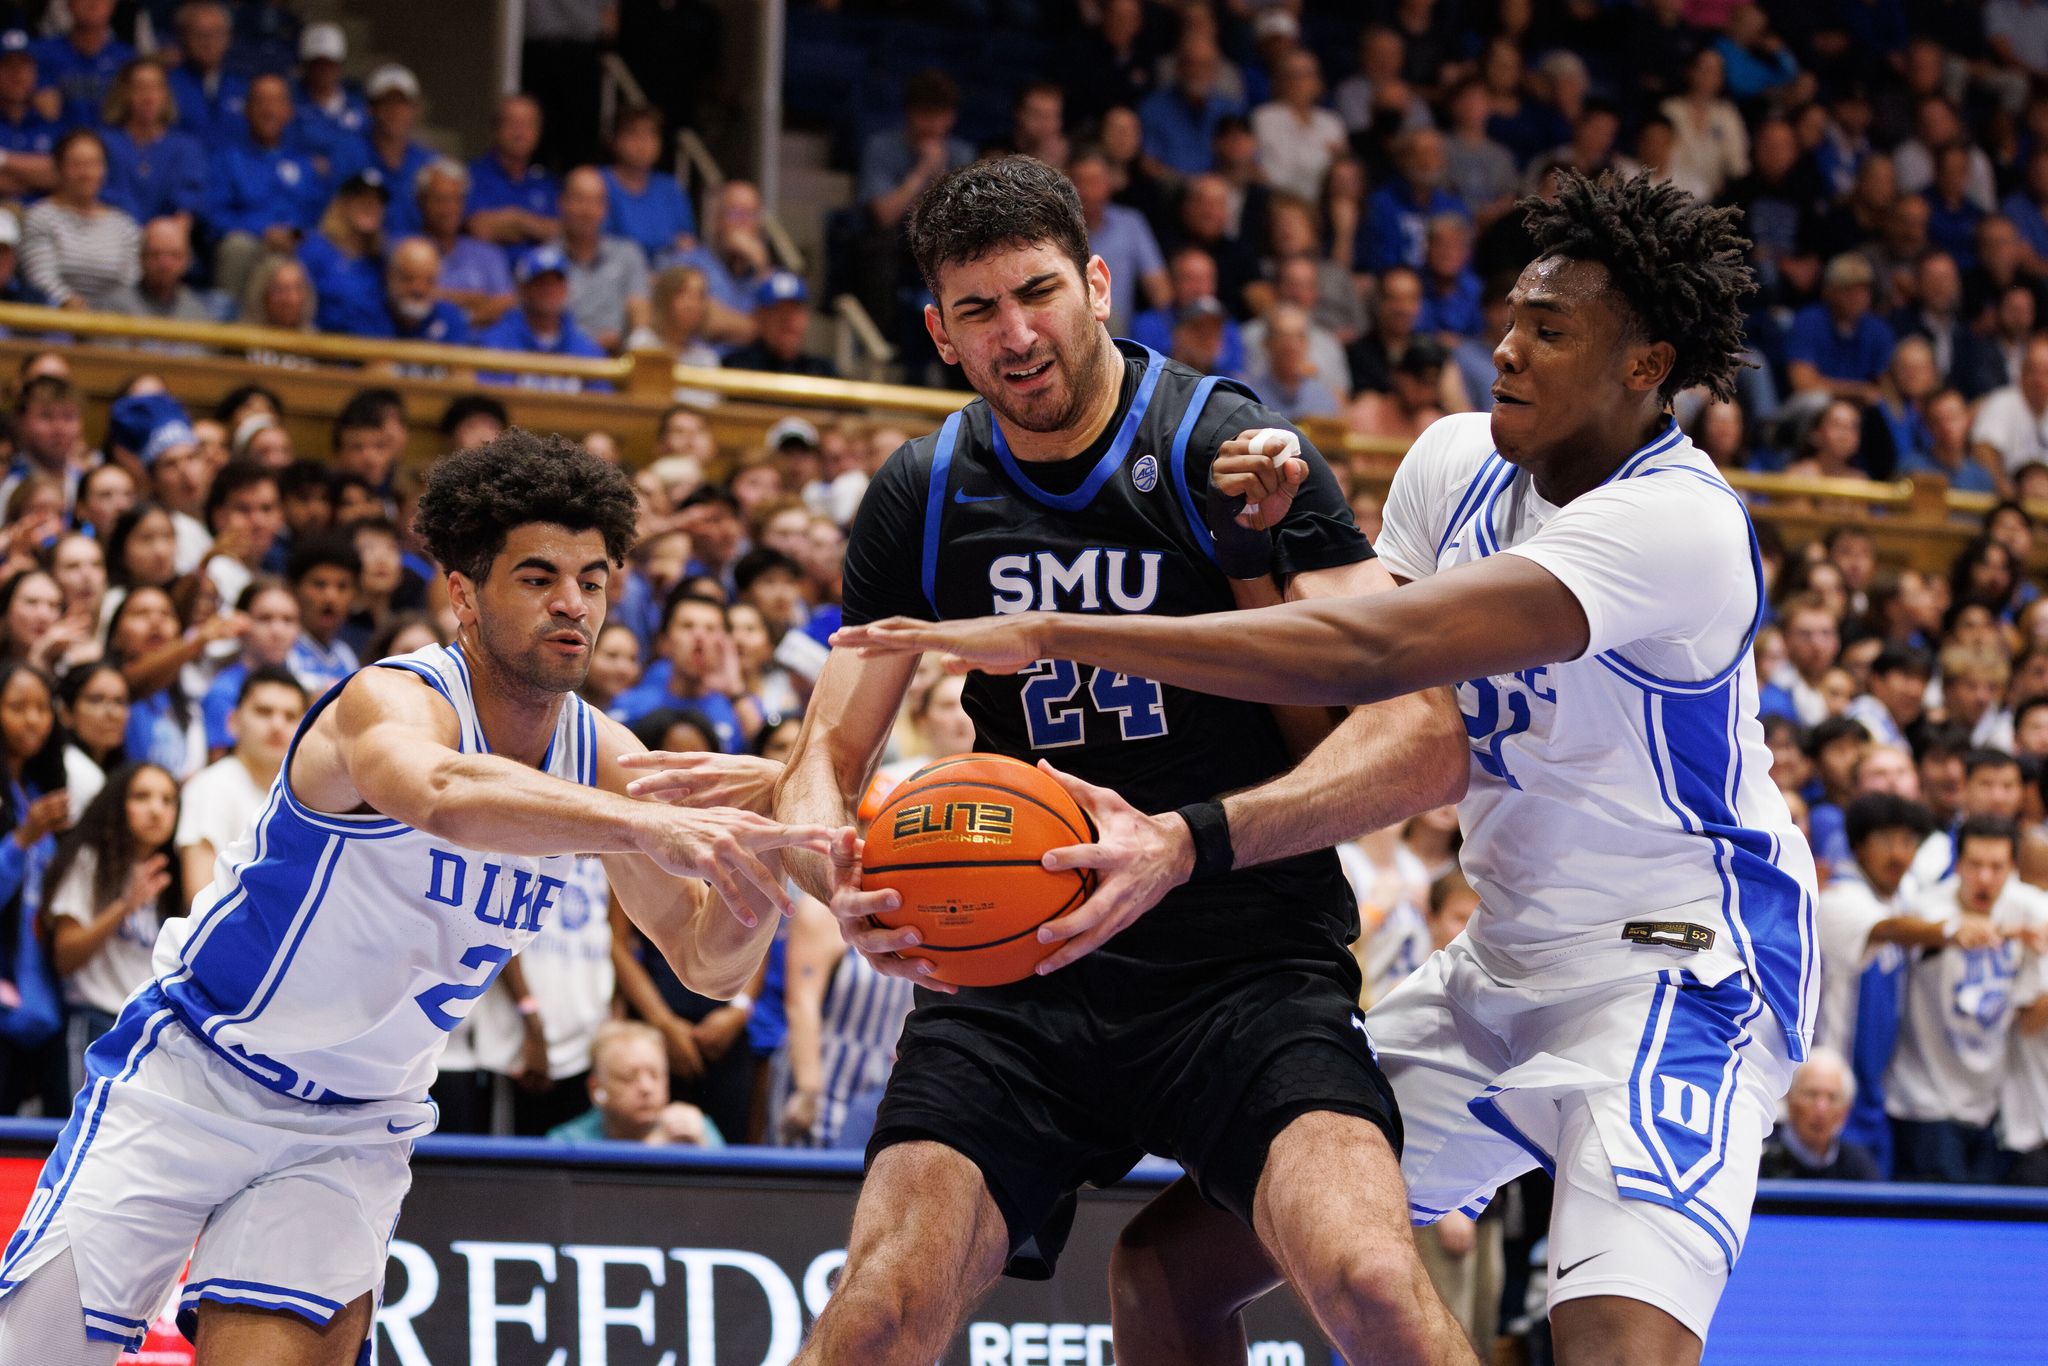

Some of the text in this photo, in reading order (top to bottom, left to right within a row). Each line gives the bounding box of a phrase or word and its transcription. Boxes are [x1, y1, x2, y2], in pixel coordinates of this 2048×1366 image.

[989, 548, 1164, 615] SMU
[1017, 658, 1169, 750] 24
[893, 802, 1014, 840] ELITE
[425, 848, 567, 932] DUKE
[1691, 929, 1708, 943] 52
[414, 943, 513, 1032] 2
[1657, 1073, 1711, 1136] D
